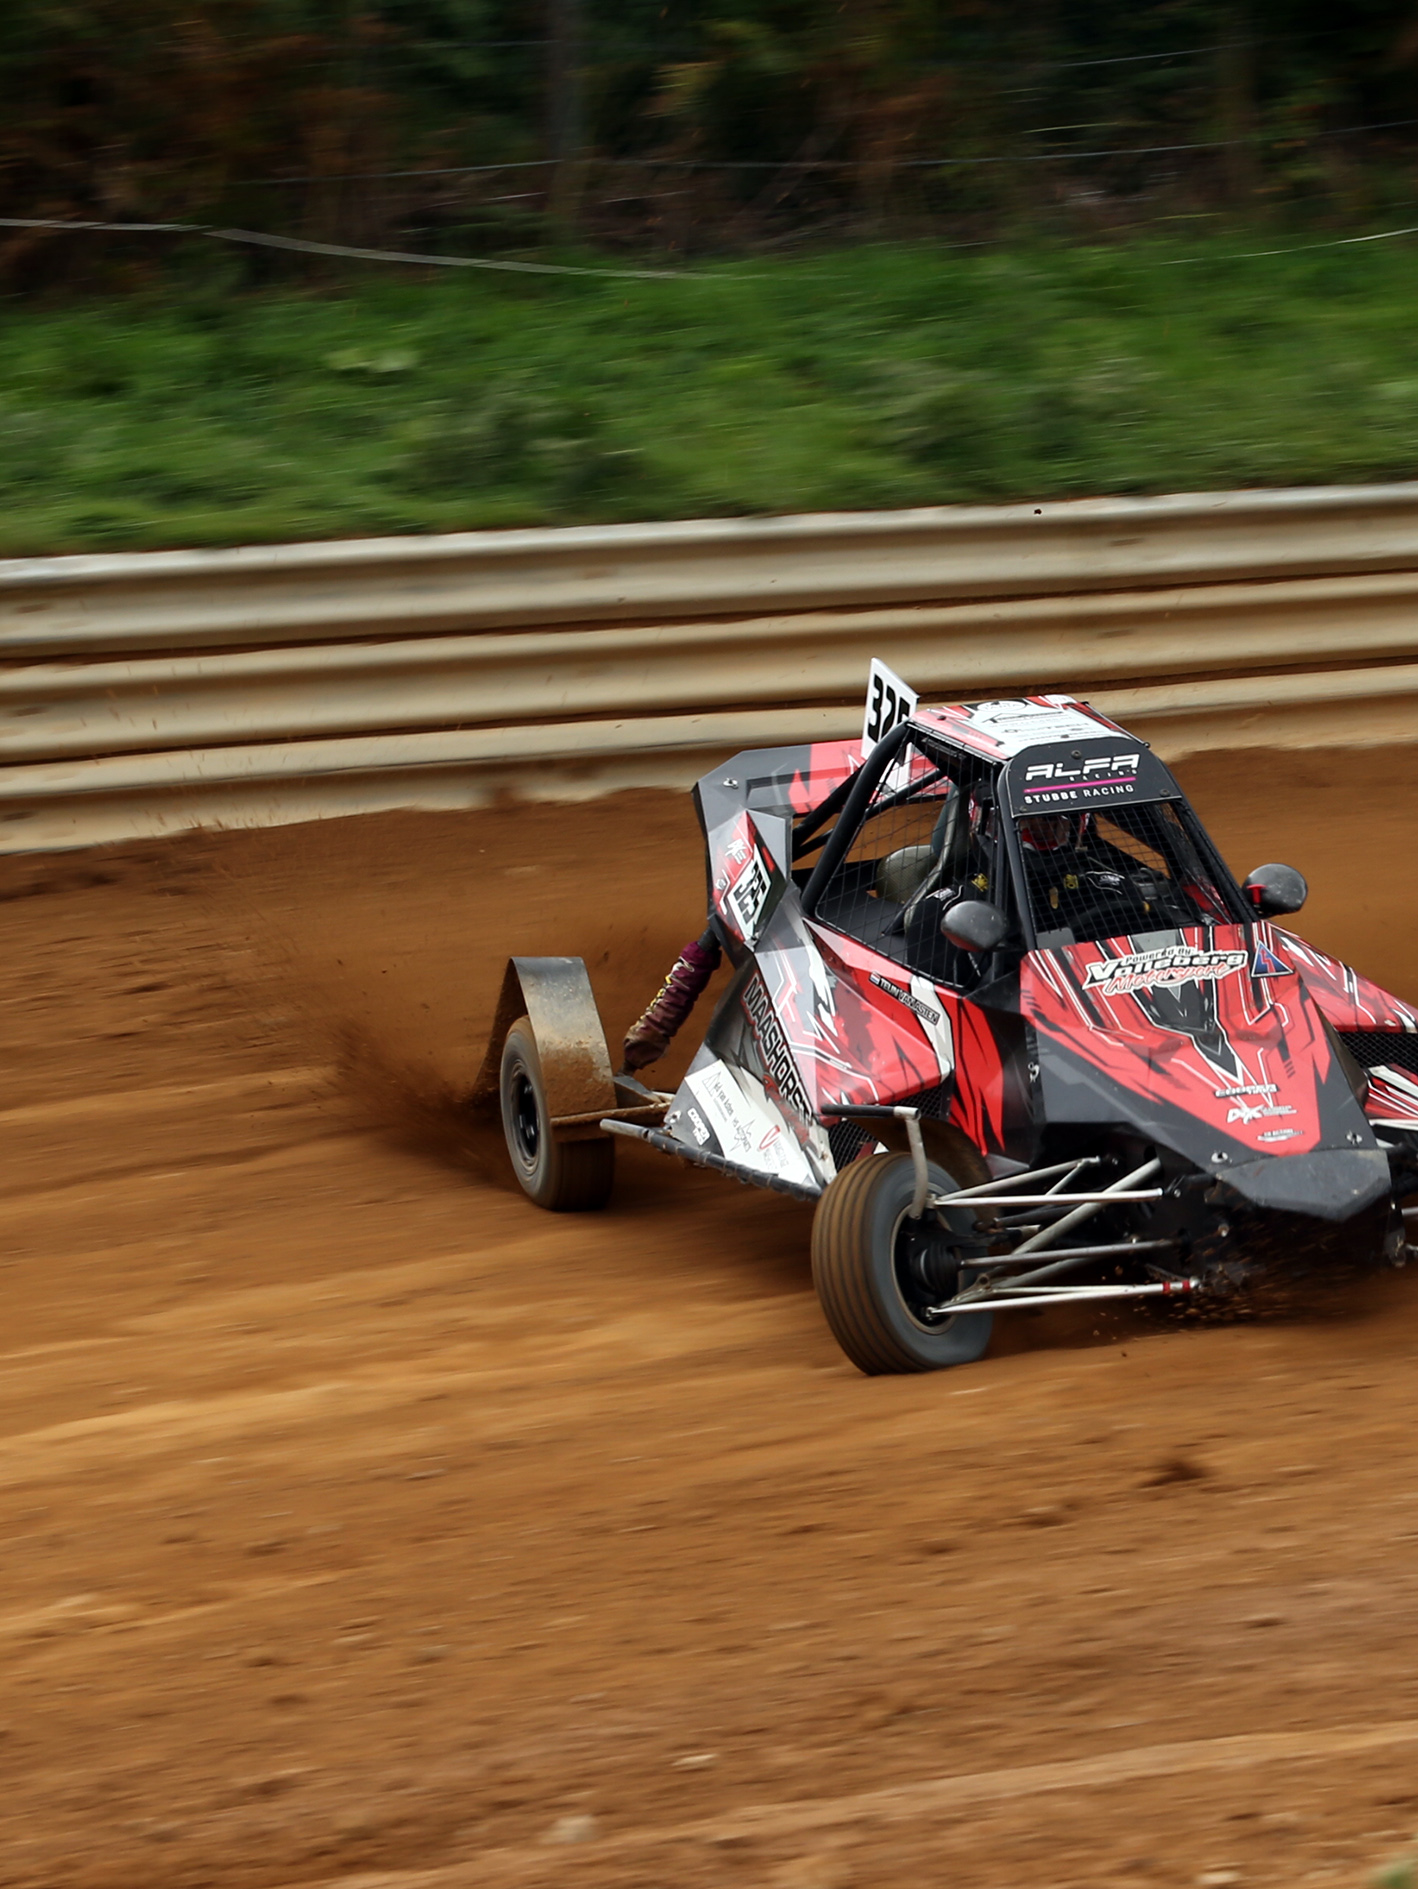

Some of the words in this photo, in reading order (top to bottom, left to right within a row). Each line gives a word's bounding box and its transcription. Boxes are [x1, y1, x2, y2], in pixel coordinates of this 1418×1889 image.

[1026, 754, 1140, 781] ALFA
[1024, 791, 1078, 804] STUBBE
[1083, 784, 1135, 797] RACING
[732, 860, 767, 925] 325
[1125, 948, 1174, 964] Powered
[1106, 962, 1228, 993] Motorsport
